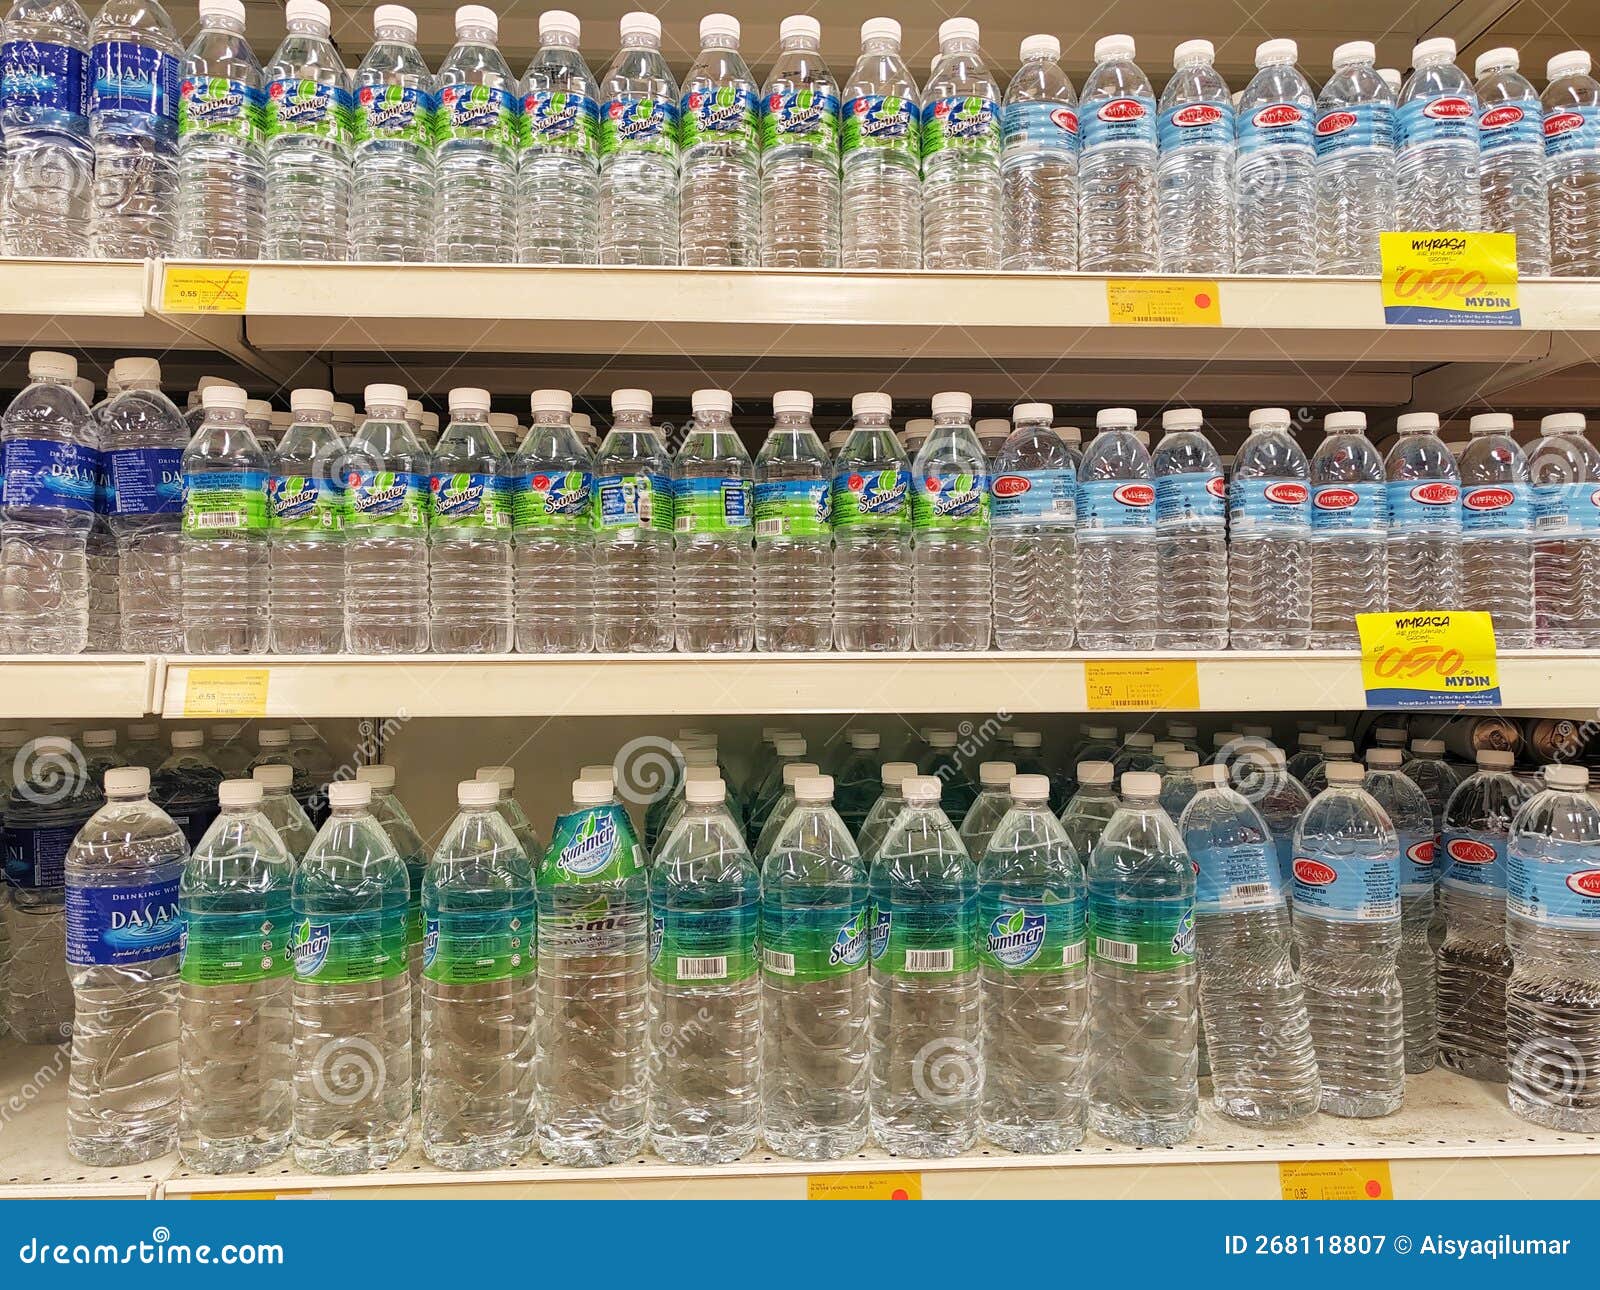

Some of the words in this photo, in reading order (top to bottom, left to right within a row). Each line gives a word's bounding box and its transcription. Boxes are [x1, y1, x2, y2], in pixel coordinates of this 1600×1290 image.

[1411, 238, 1466, 252] MYRASA
[1465, 297, 1511, 308] MYDIN
[1395, 616, 1450, 629] MYRASA
[1445, 675, 1490, 687] MYDIN
[558, 825, 614, 867] Summer
[112, 889, 161, 901] DRINKING
[111, 902, 181, 930] DASAN
[986, 926, 1043, 953] Summer
